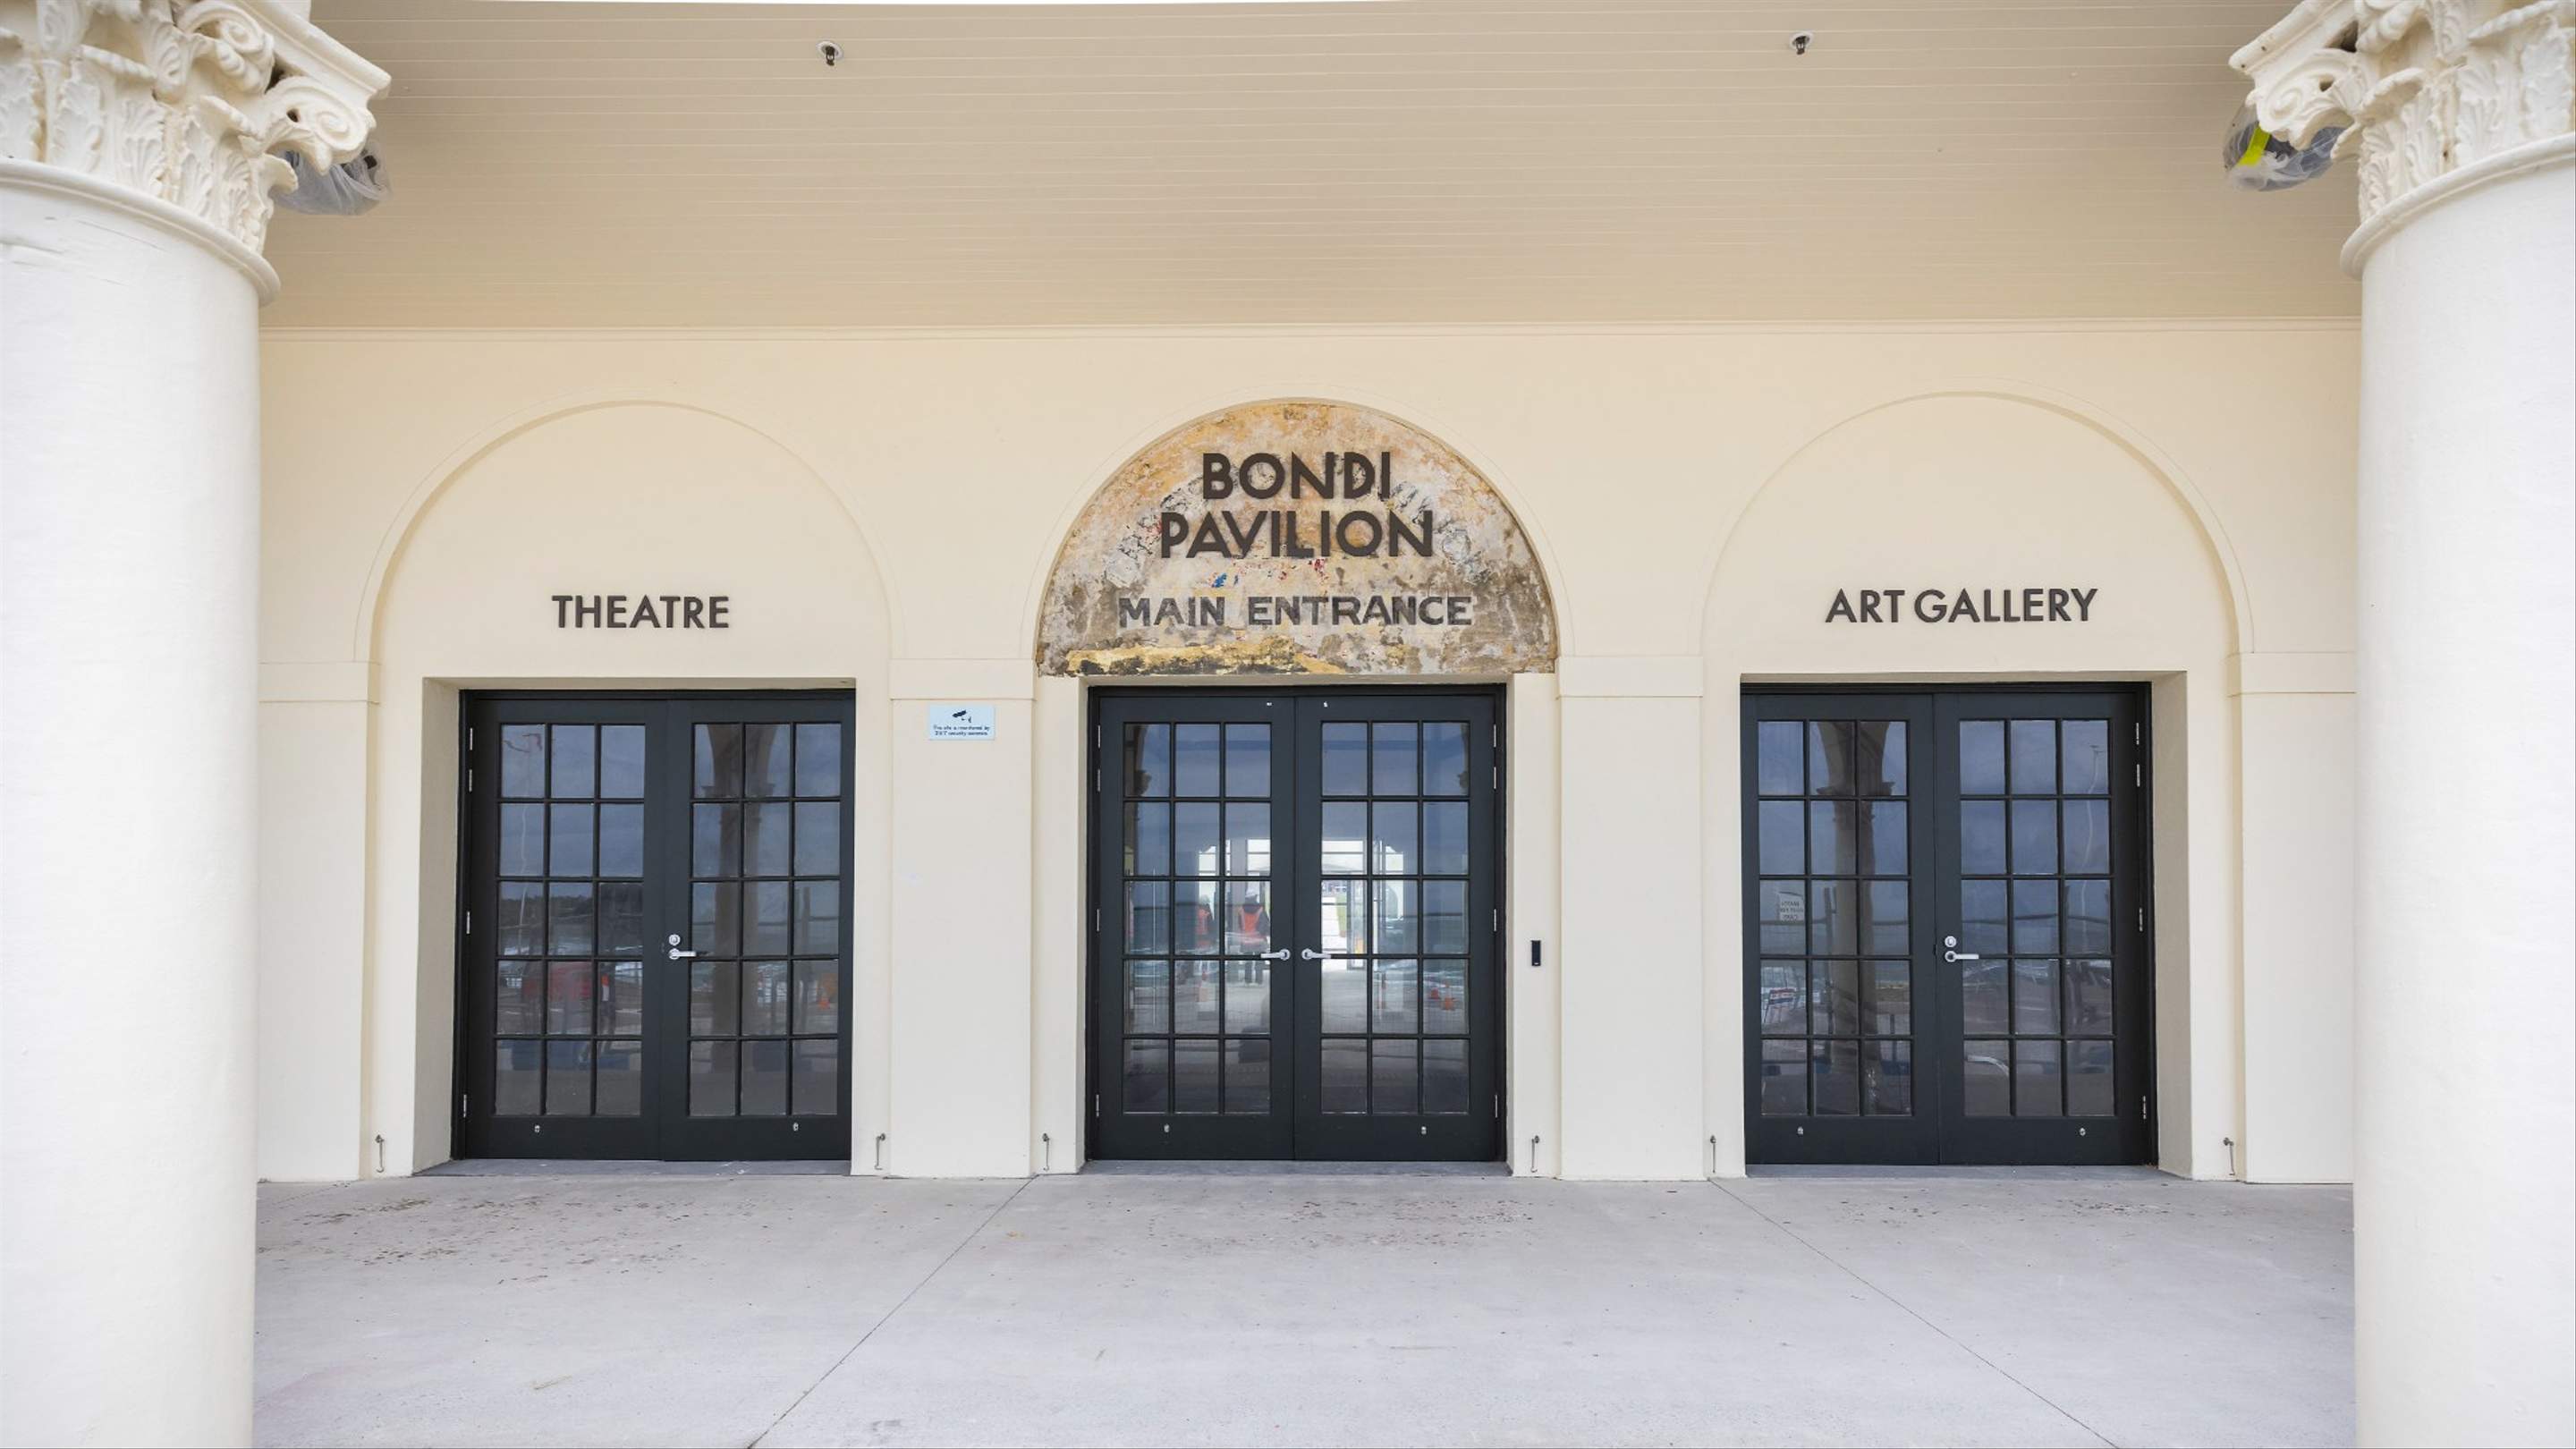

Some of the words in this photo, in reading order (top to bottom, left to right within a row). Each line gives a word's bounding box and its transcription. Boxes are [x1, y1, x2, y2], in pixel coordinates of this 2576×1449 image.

[1201, 451, 1390, 499] BONDI
[1161, 511, 1432, 558] PAVILION
[551, 594, 729, 629] THEATRE
[1118, 597, 1225, 627] MAIN
[1248, 595, 1472, 626] ENTRANCE
[1825, 588, 1906, 623] ART
[1914, 588, 2098, 623] GALLERY
